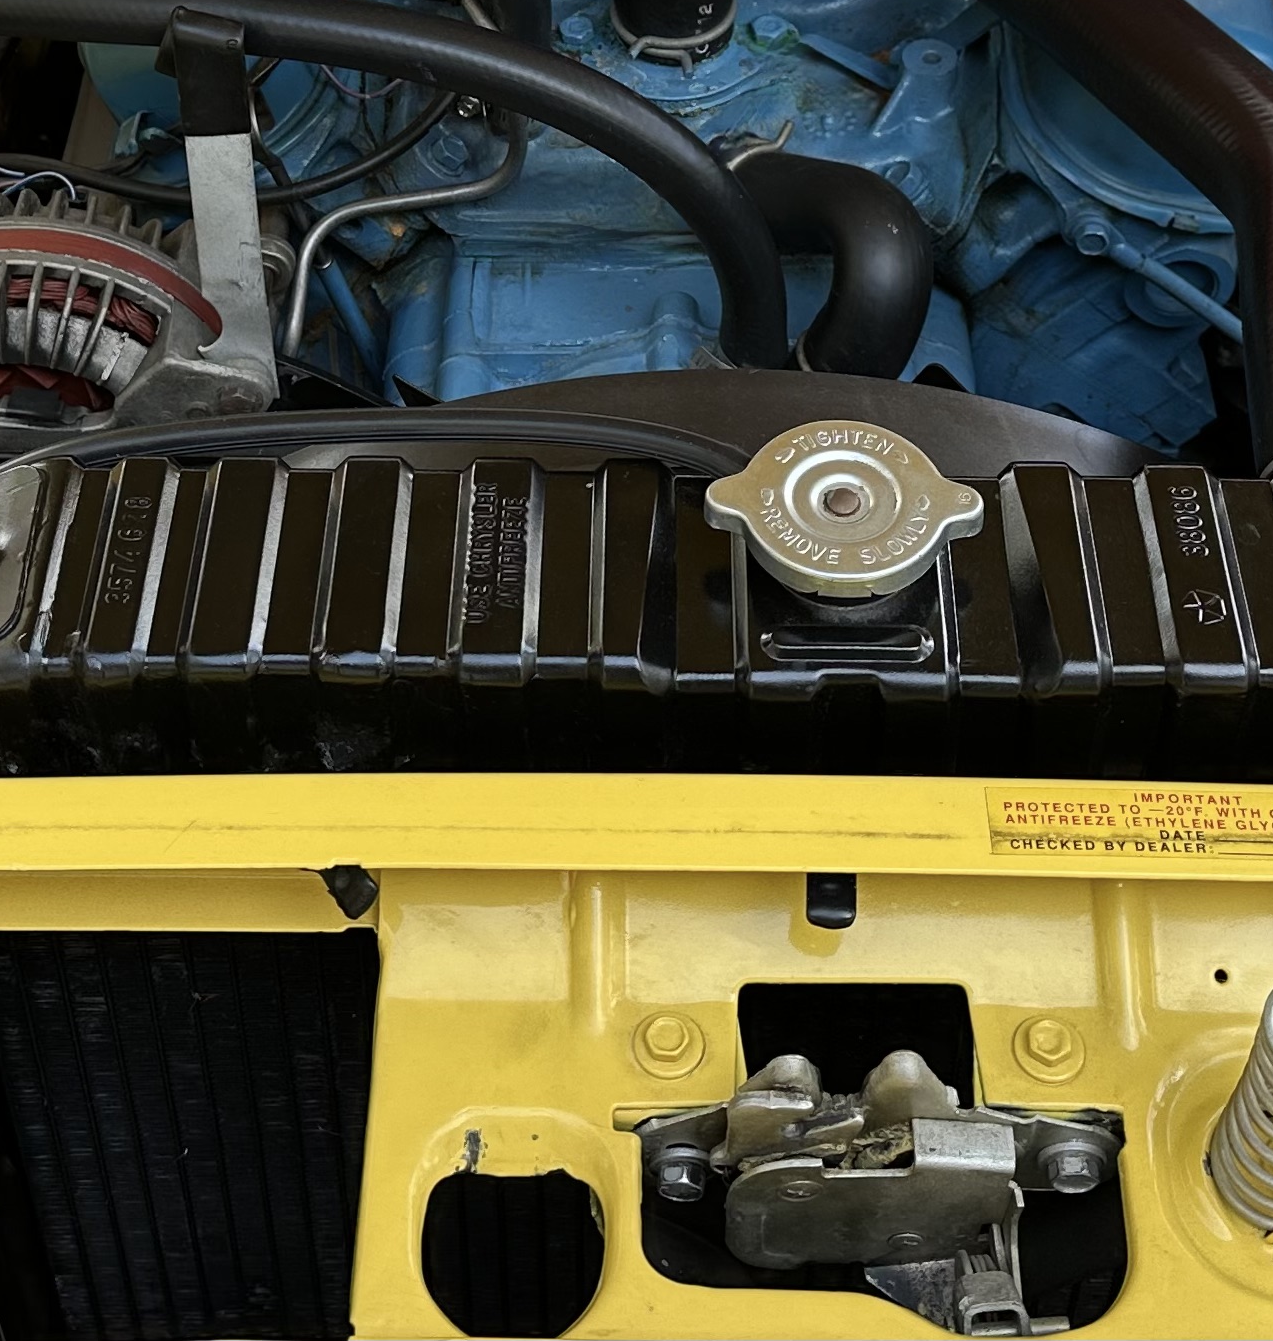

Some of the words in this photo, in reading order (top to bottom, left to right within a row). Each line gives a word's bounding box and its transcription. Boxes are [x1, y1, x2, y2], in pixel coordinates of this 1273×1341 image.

[792, 429, 895, 456] TIGHTEN
[469, 482, 499, 578] CHRYSLER
[759, 506, 842, 565] REMOVE
[859, 513, 930, 565] SLOWLY
[494, 496, 526, 609] ANTIFREEZE
[466, 583, 494, 624] USE
[1004, 802, 1110, 814] PROTECTED
[1118, 804, 1141, 815] TO
[1216, 807, 1261, 819] WITH
[1133, 793, 1242, 806] IMPORTANT
[1005, 814, 1117, 826] ANTIFREEZE
[1125, 816, 1227, 830] (ETHYLENE
[1010, 838, 1095, 851] CHECKED
[1104, 840, 1126, 852] BY
[1135, 841, 1214, 854] DEALER:
[1159, 829, 1206, 841] DATE
